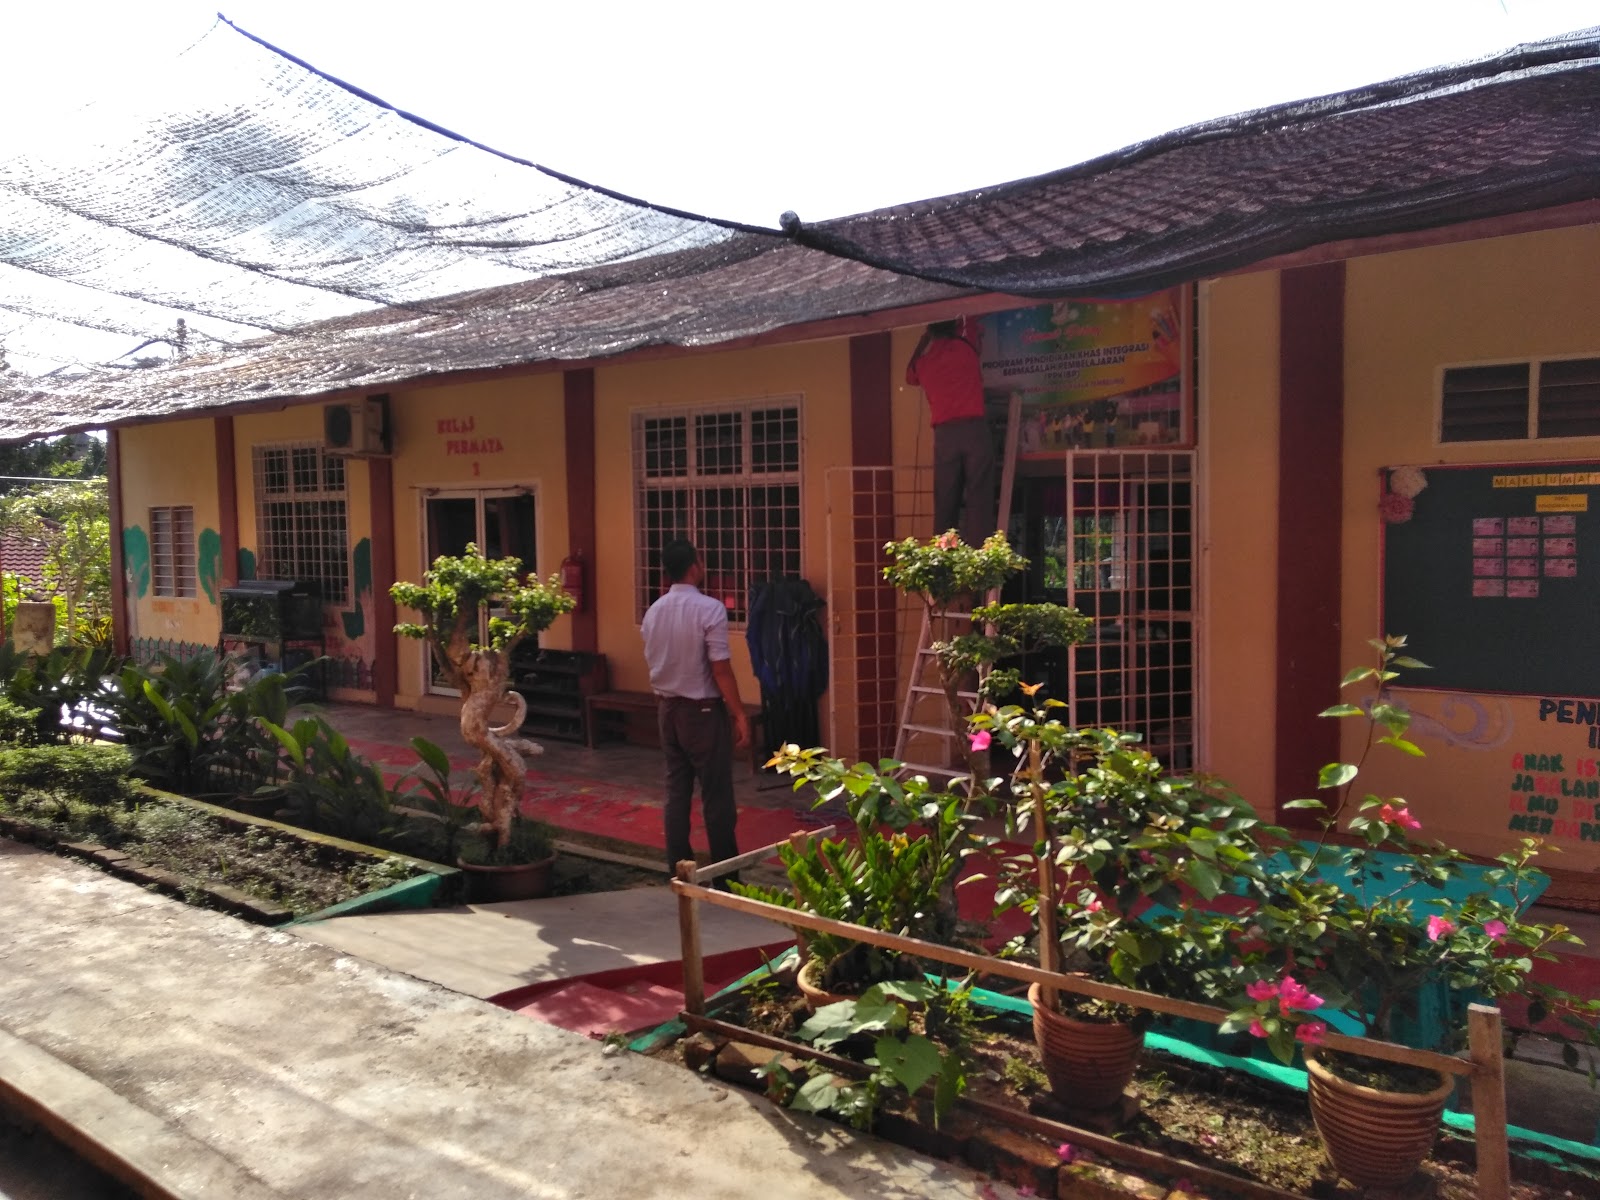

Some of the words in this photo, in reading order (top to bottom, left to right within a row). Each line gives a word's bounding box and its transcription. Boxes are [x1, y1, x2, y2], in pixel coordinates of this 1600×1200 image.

[982, 357, 1023, 369] PROGRAM
[1025, 351, 1077, 365] PENDIDIKAN
[1078, 347, 1101, 359] KHAS
[1103, 342, 1150, 356] INTEGRASI
[1003, 363, 1056, 376] BERMASALAH
[1058, 355, 1126, 370] PEMBELAJARAN
[437, 415, 475, 434] KELAS
[446, 437, 504, 456] PERMATA
[1539, 698, 1600, 726] PEN
[1511, 752, 1565, 774] ANAK
